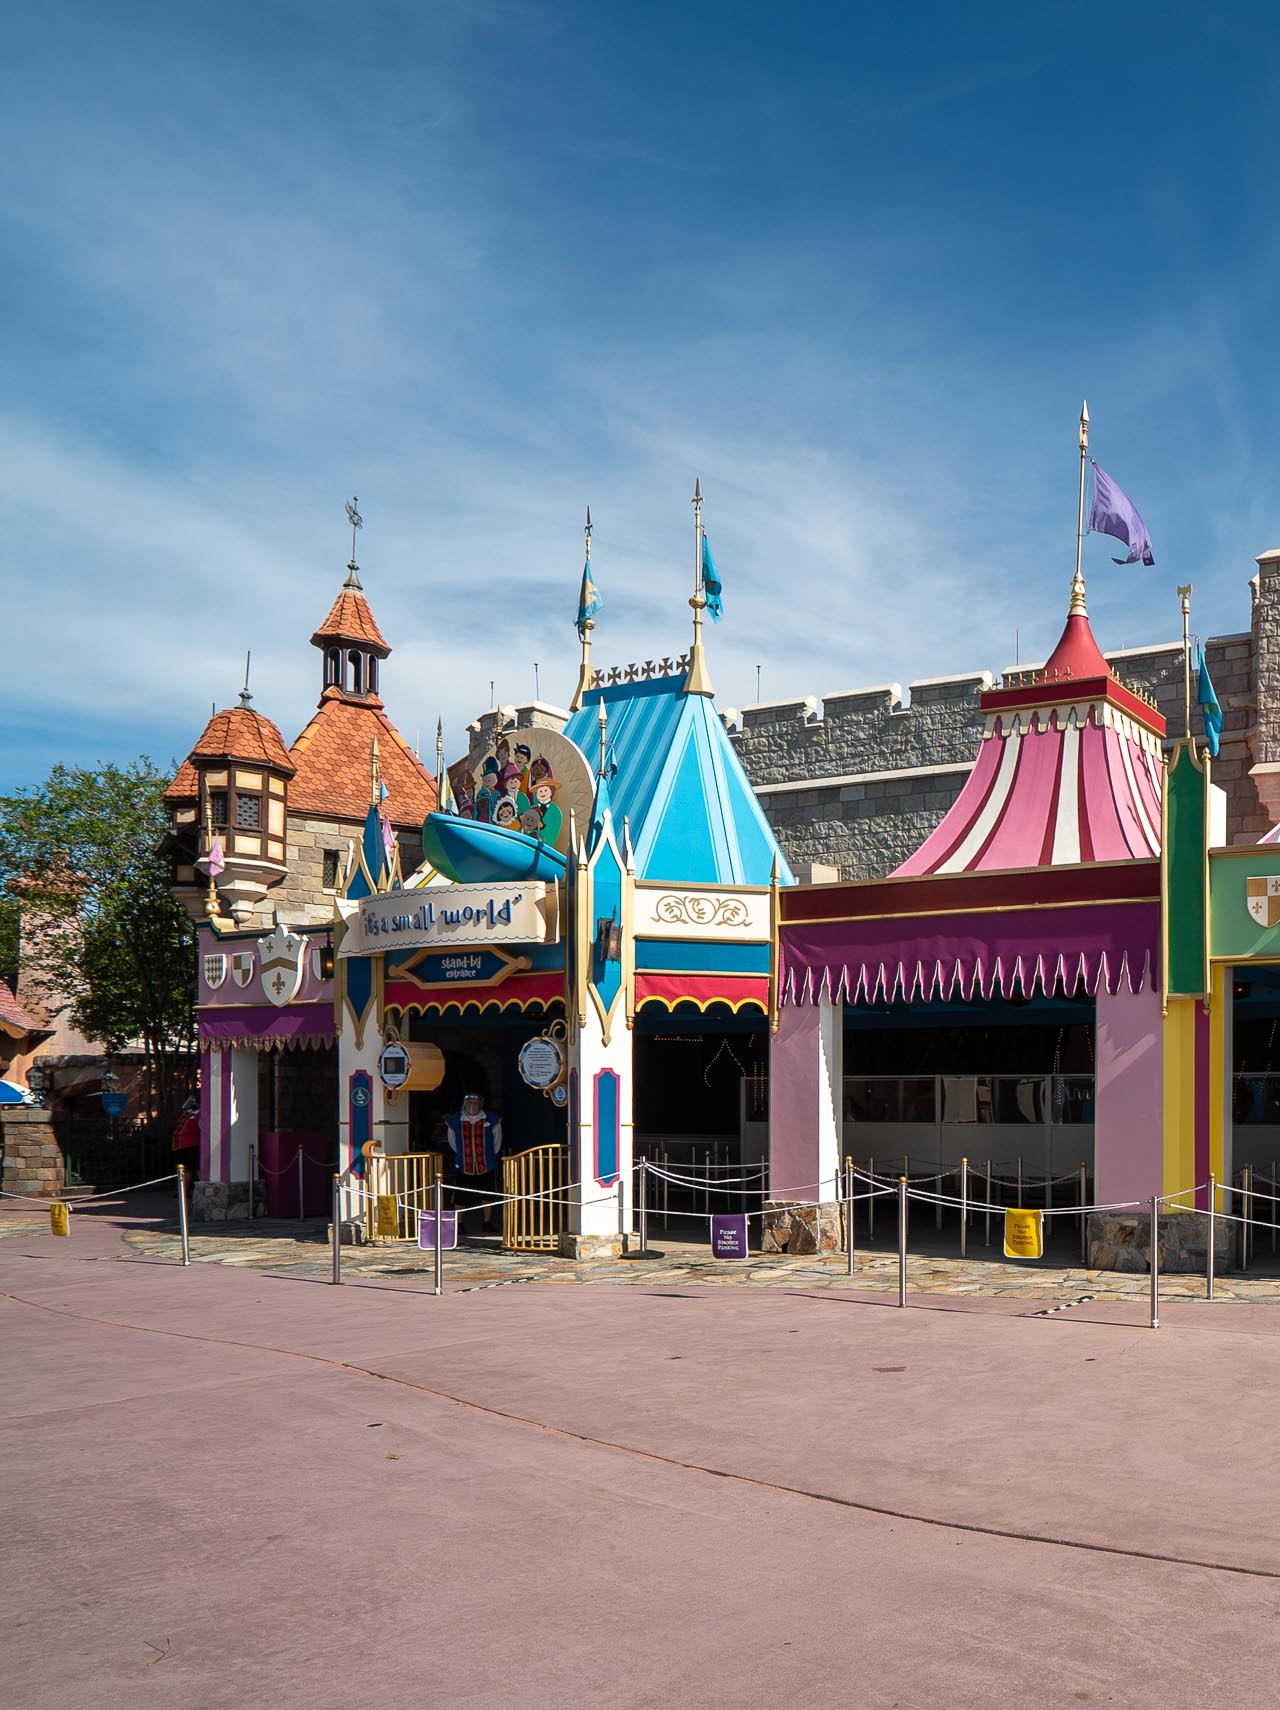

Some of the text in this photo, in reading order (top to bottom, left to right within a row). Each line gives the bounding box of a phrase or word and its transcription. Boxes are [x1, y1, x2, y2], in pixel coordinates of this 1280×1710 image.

[392, 903, 435, 932] small
[441, 955, 481, 969] stand-by
[446, 970, 477, 978] entrance
